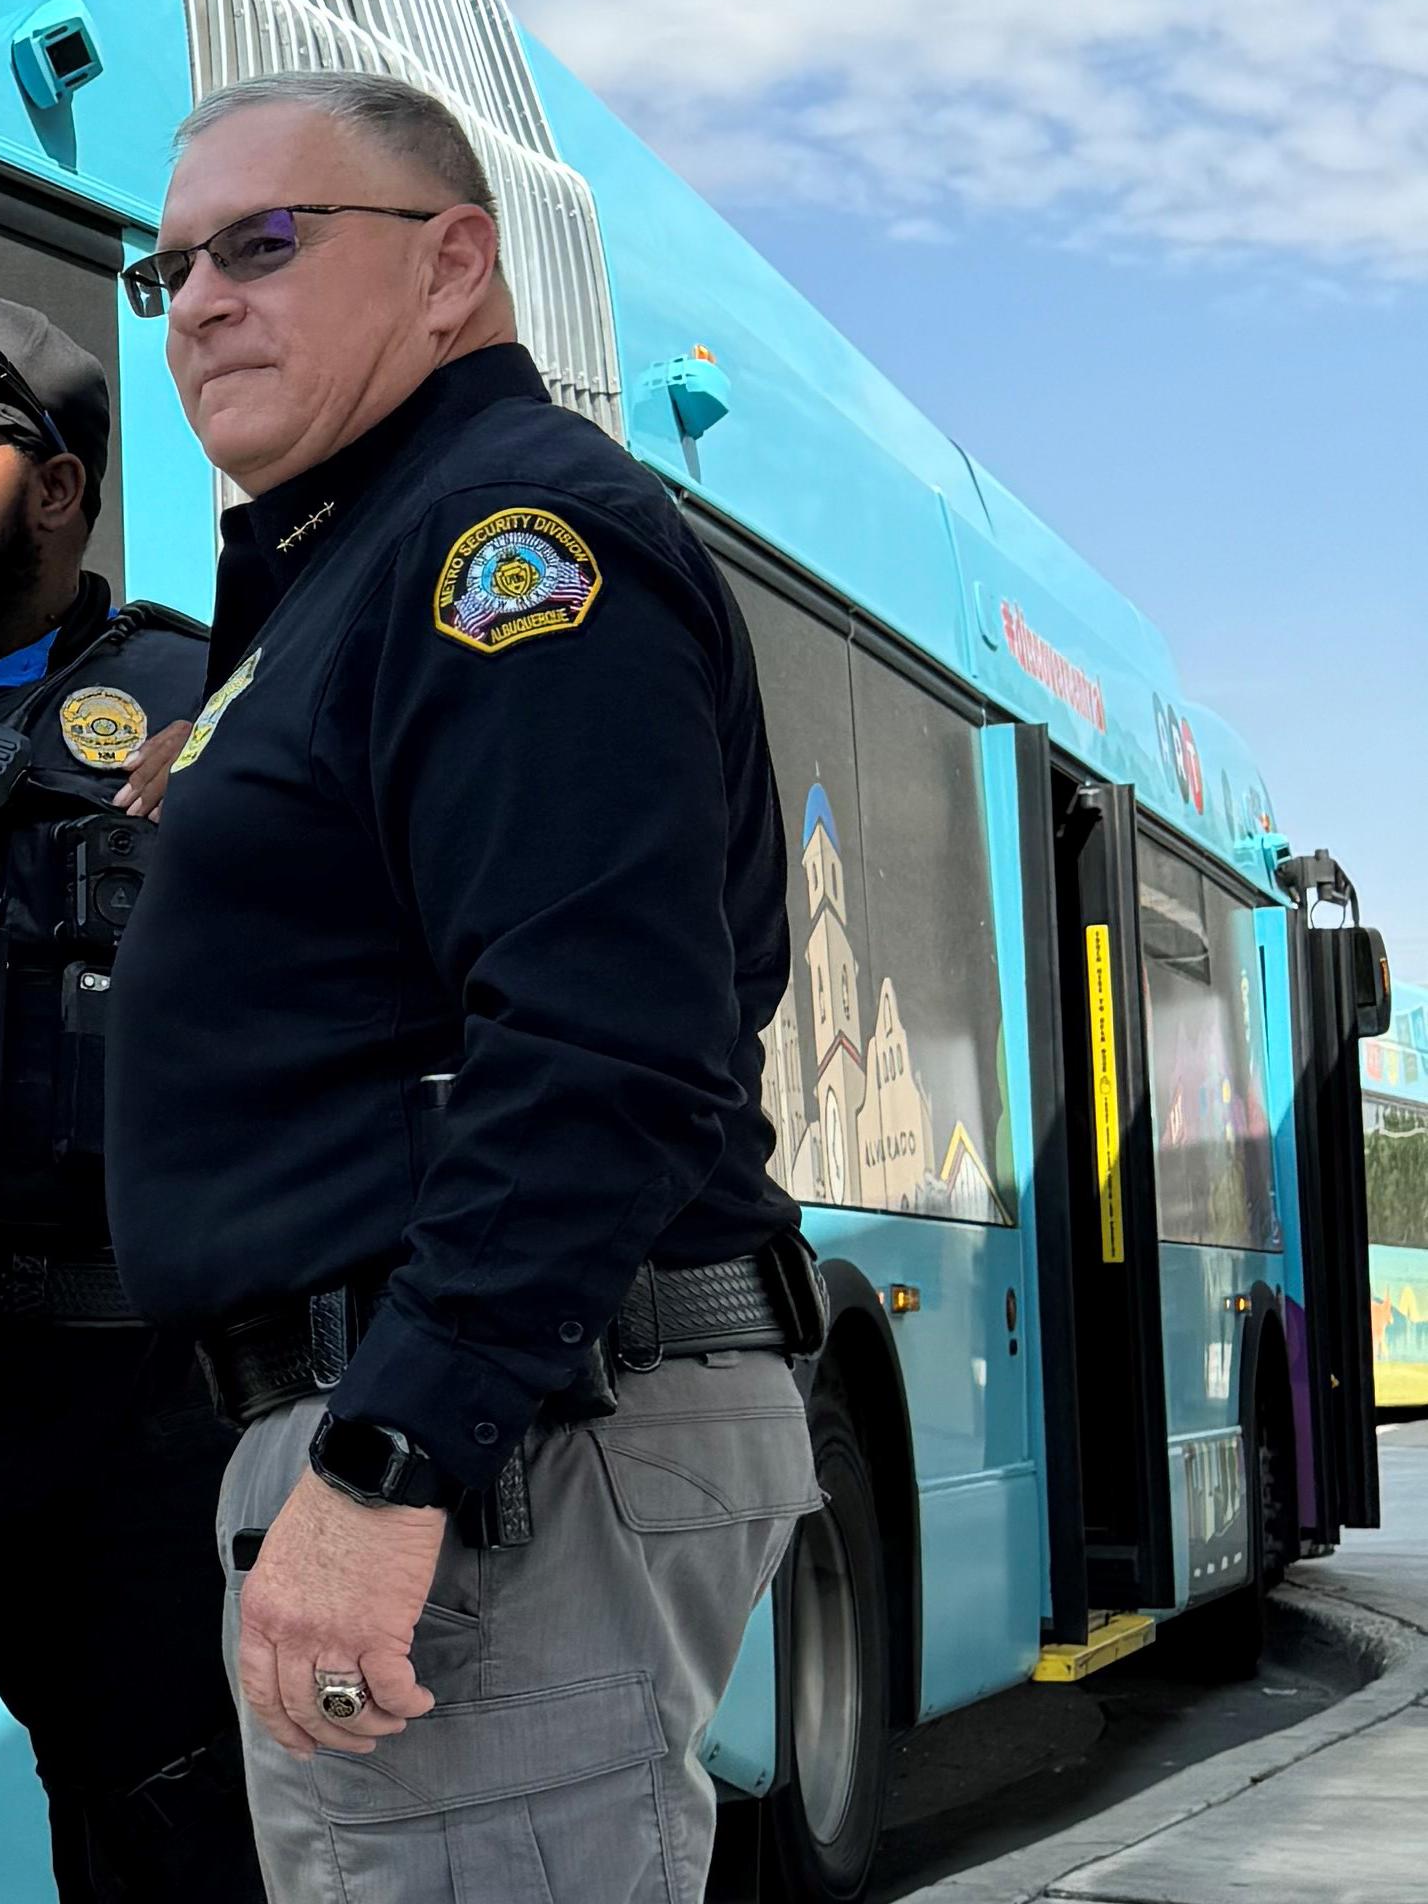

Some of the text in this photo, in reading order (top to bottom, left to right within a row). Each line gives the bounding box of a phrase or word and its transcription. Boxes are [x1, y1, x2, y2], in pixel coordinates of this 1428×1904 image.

[439, 557, 464, 607] METRO
[459, 515, 532, 557] SECURITY
[534, 516, 589, 563] DIVISION
[490, 608, 569, 643] ALBUQUERQUE
